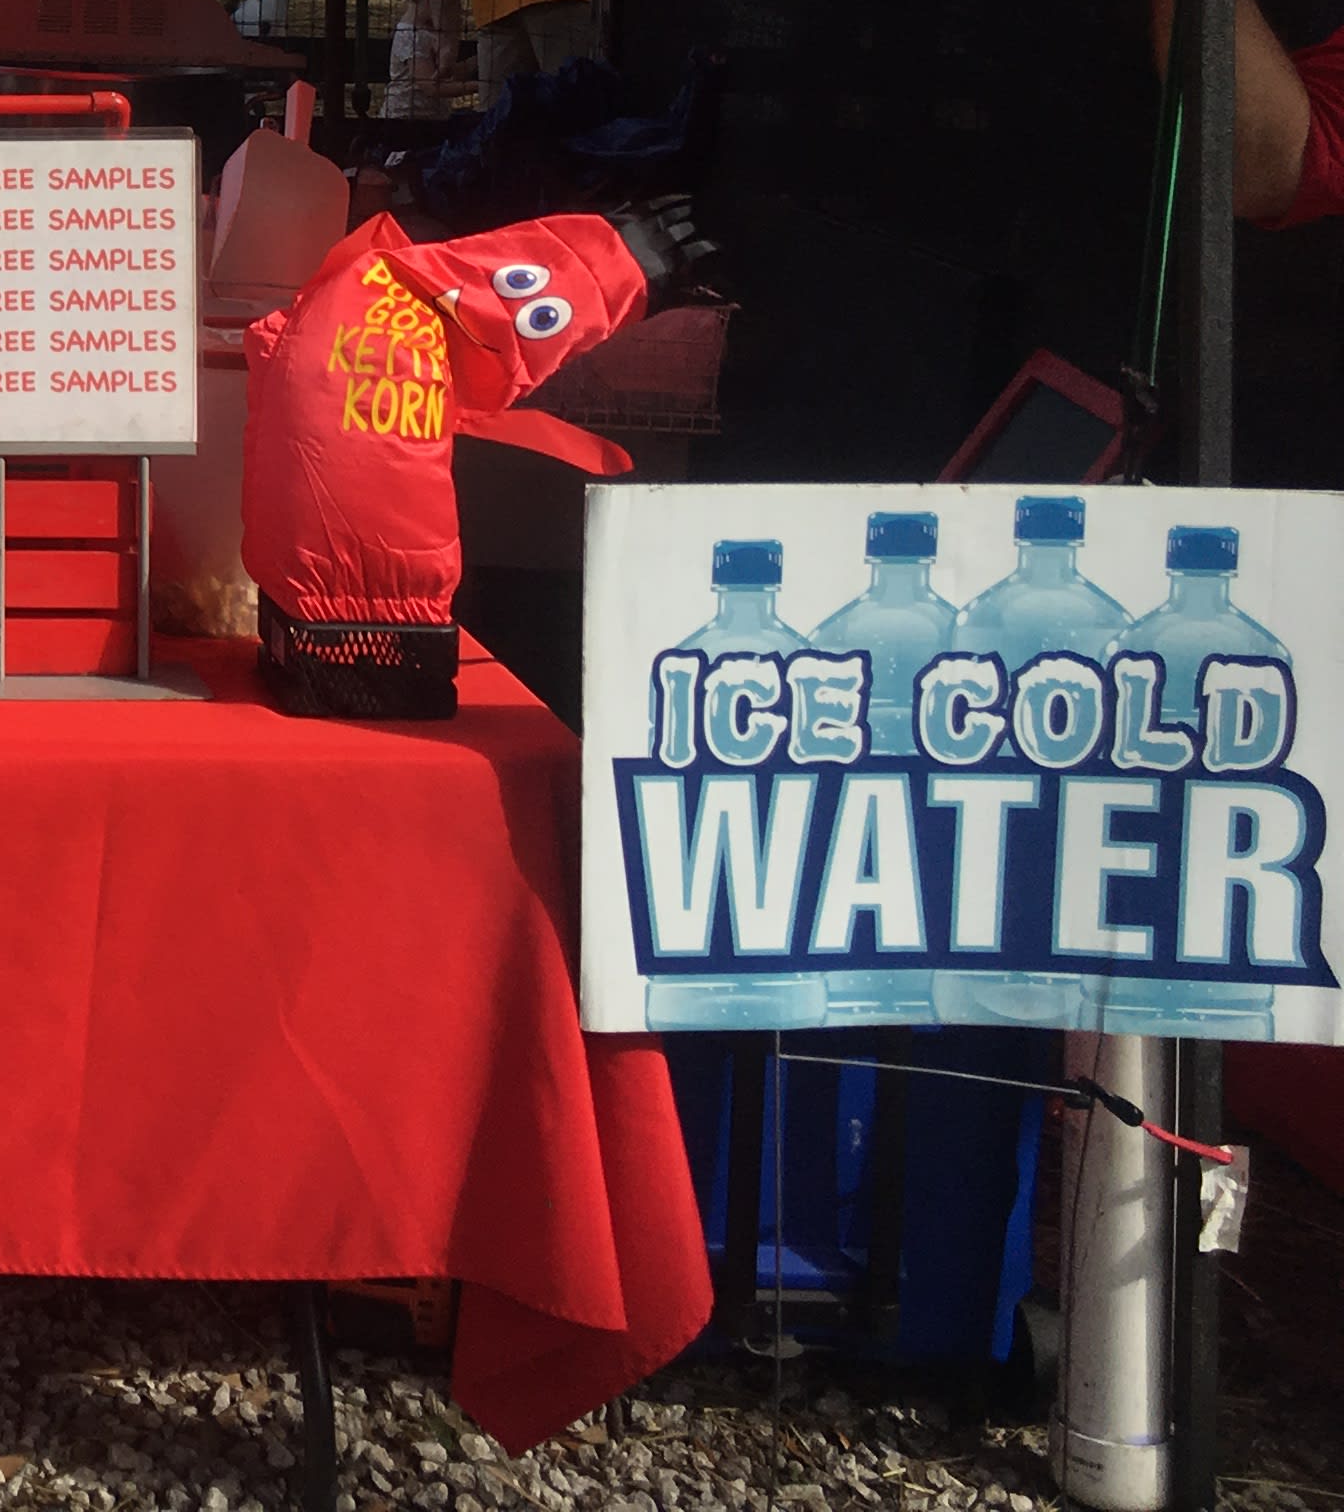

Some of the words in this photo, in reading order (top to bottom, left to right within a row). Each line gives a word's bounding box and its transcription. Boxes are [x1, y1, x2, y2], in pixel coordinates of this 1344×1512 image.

[47, 167, 177, 191] SAMPLES
[47, 208, 177, 232] SAMPLES
[47, 248, 177, 272] SAMPLES
[47, 289, 177, 313] SAMPLES
[47, 329, 177, 353] SAMPLES
[47, 370, 177, 394] SAMPLES
[342, 376, 447, 441] KORN
[652, 648, 873, 769] ICE
[912, 650, 1299, 774] COLD
[632, 772, 1309, 970] WATER
